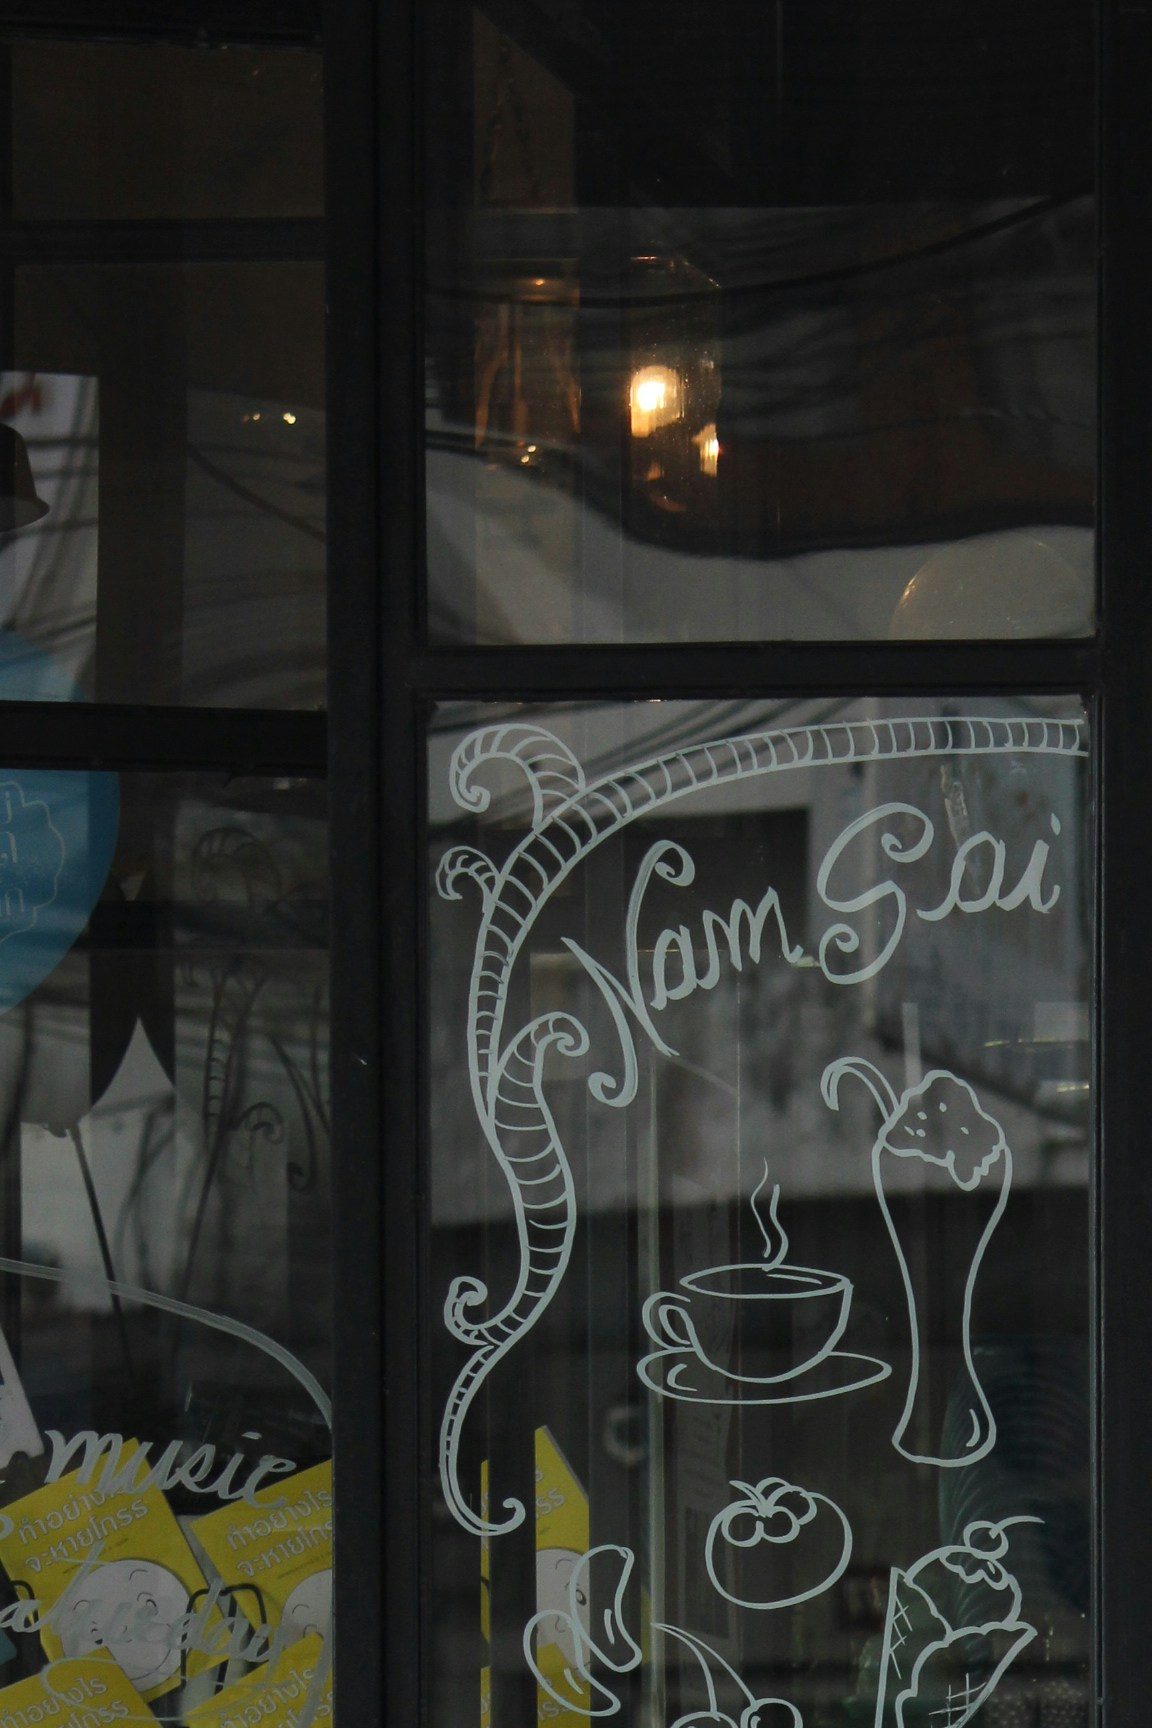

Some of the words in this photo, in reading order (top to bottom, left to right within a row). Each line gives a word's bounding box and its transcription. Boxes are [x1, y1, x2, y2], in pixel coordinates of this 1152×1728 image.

[560, 839, 804, 1108] Nam
[45, 1429, 297, 1510] music
[18, 1483, 126, 1545] ทำอย่าง
